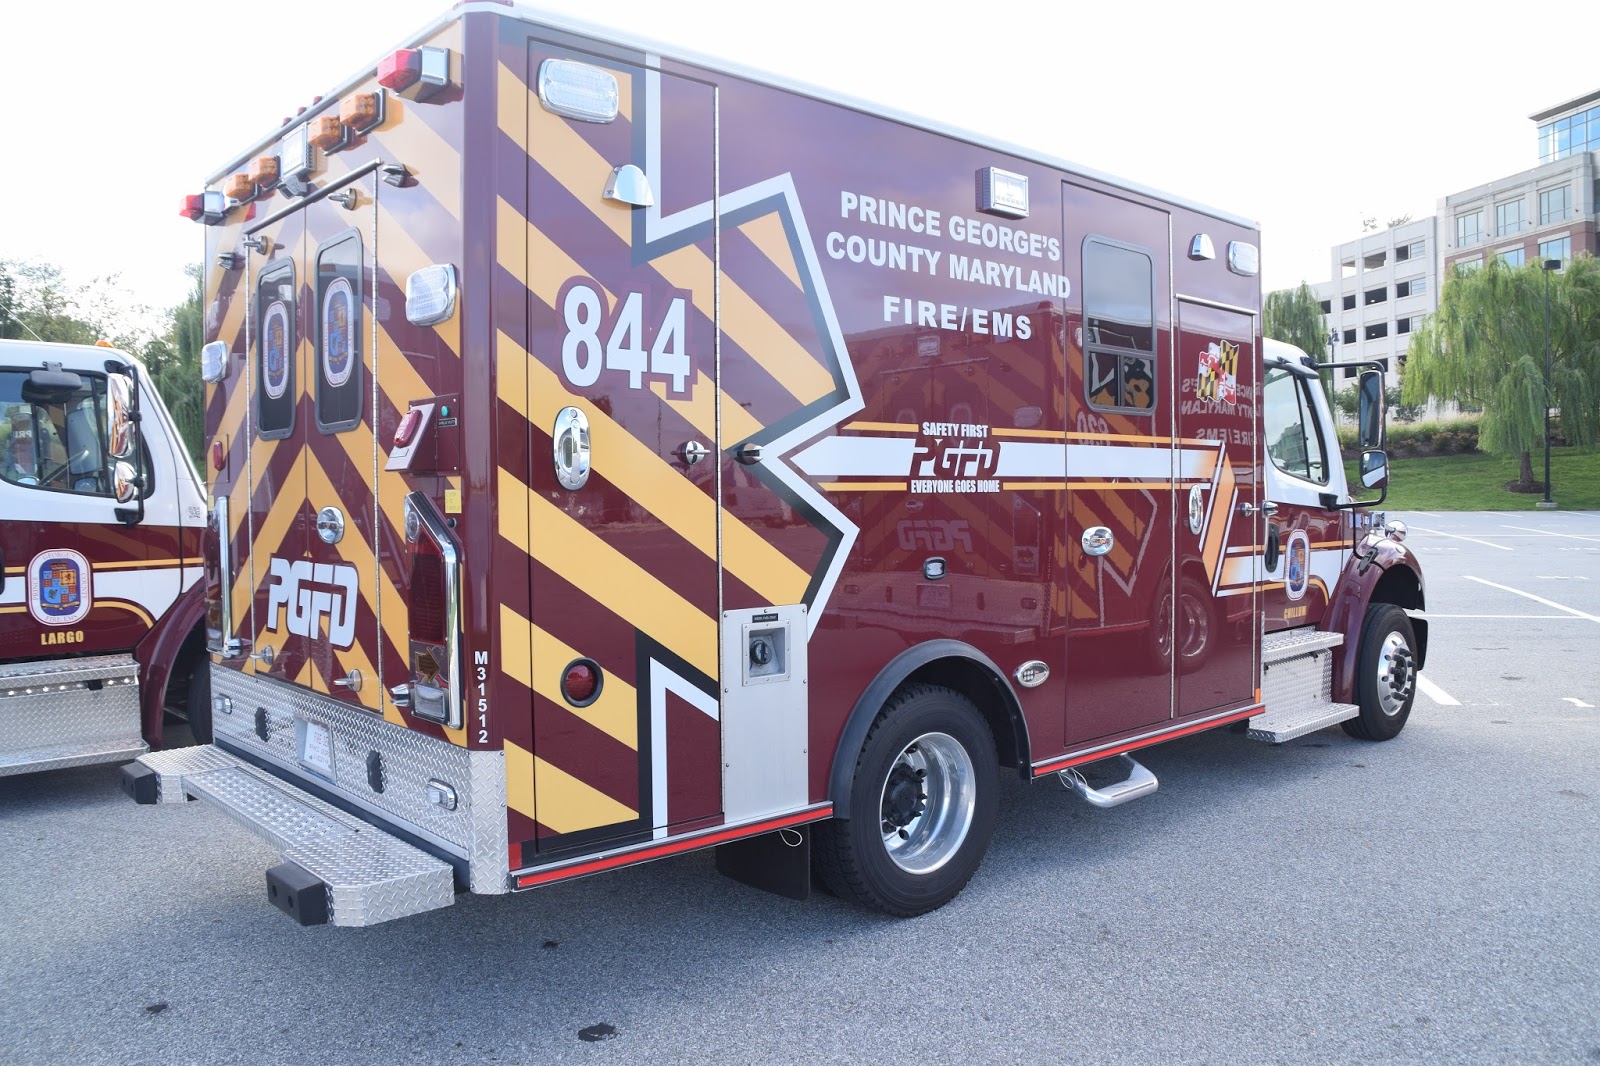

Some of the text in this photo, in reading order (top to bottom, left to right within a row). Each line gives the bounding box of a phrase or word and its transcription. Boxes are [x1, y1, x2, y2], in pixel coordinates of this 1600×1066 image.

[841, 190, 1060, 262] PRINCE GEORGE'S
[826, 231, 1071, 299] COUNTY MARYLAND
[561, 285, 691, 393] 844
[883, 295, 1032, 340] FIRE/EMS
[909, 438, 1001, 477] PGFD
[922, 422, 988, 438] SAFETY FIRST
[911, 479, 1000, 494] EVERYONE GOES HOME
[267, 557, 359, 648] PGFD
[40, 630, 84, 646] LARGO
[474, 650, 489, 744] M31512
